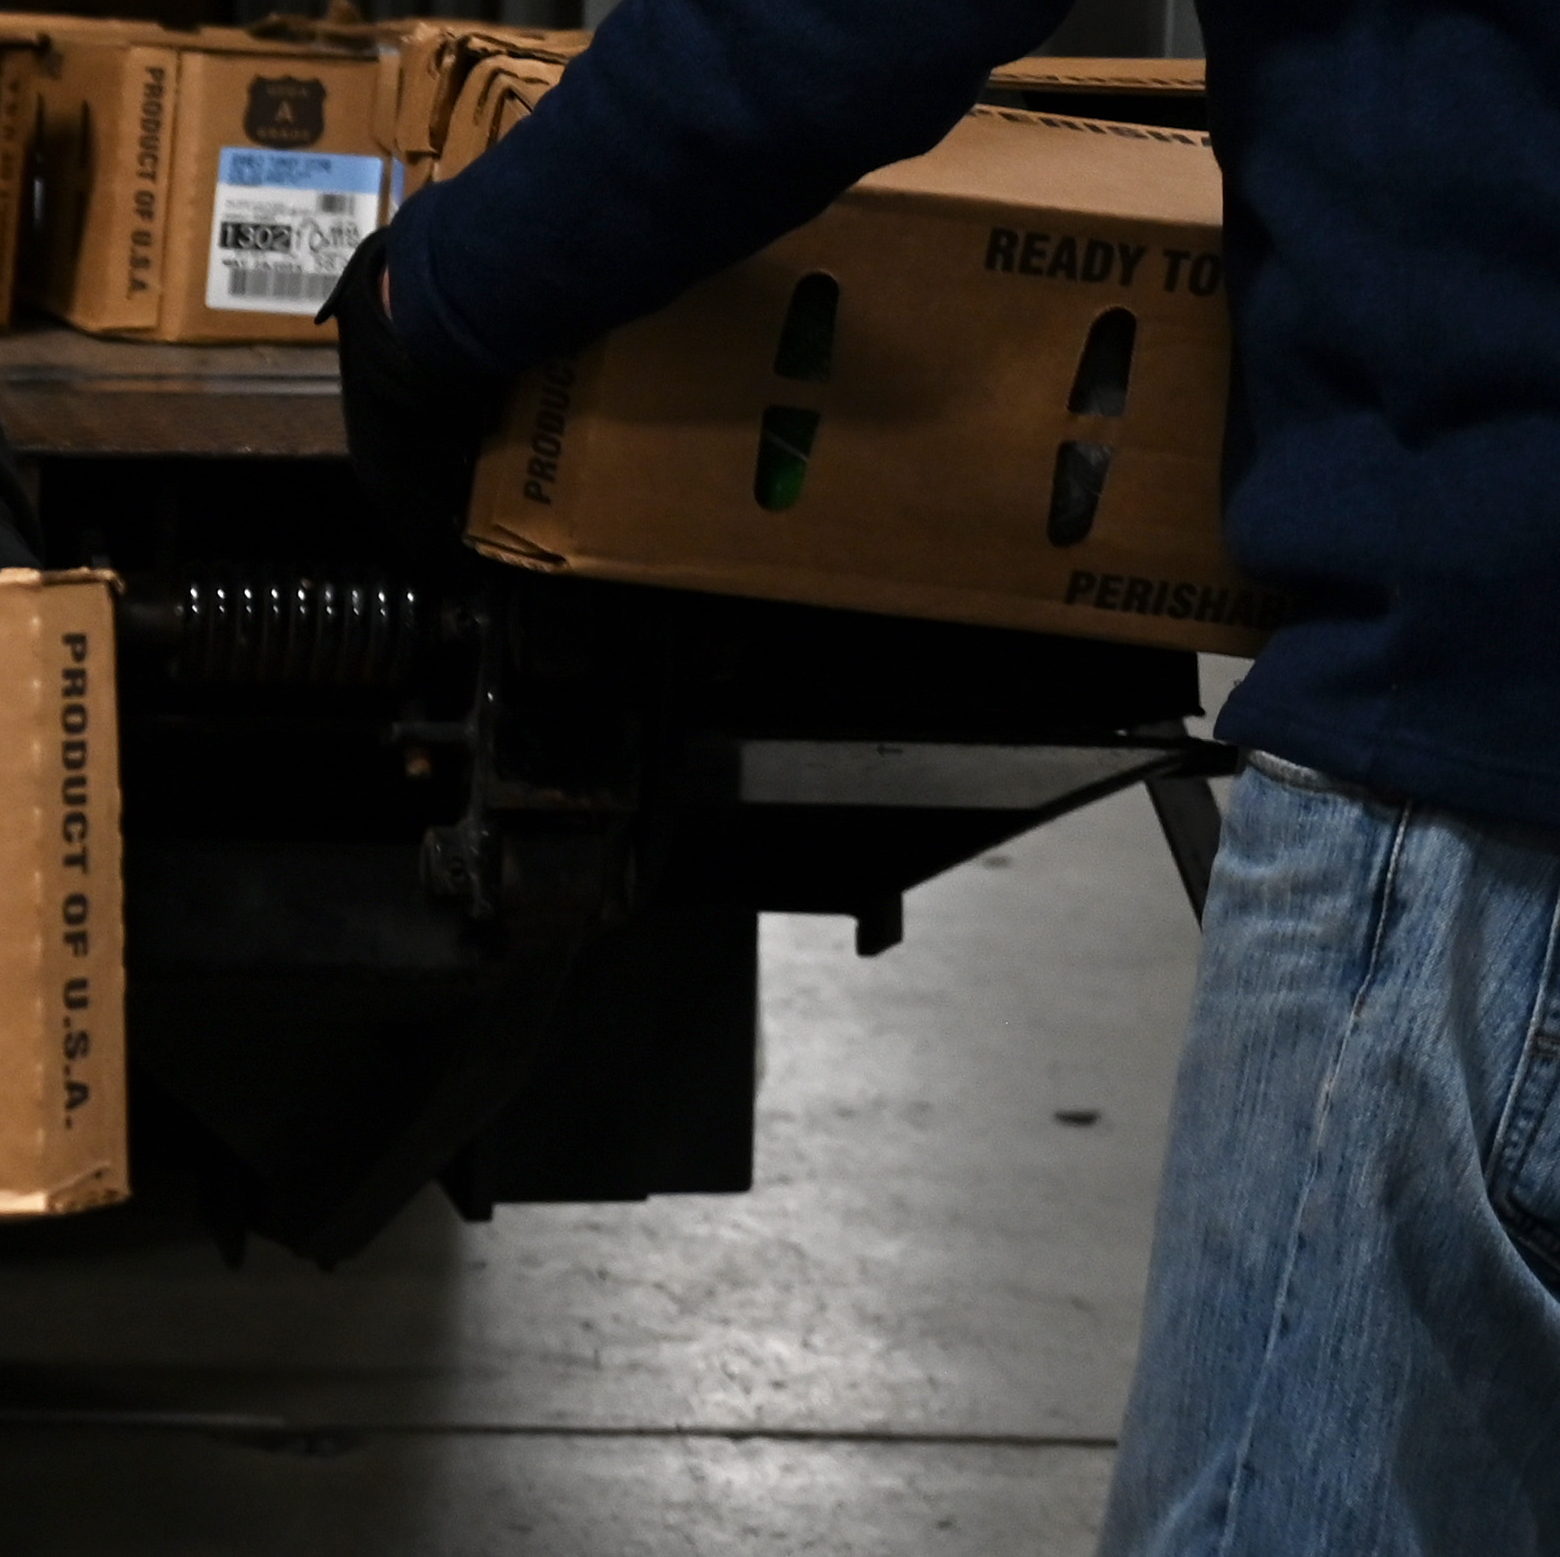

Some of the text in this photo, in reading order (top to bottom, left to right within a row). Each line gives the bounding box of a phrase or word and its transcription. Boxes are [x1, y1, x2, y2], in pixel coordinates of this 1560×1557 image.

[136, 66, 165, 181] PRODUCT
[132, 190, 156, 224] OF
[984, 226, 1222, 297] READY TO
[523, 362, 576, 506] PRODUC
[1064, 568, 1287, 631] PERISHAB
[60, 632, 91, 1130] PRODUCT OF U.S.A.
